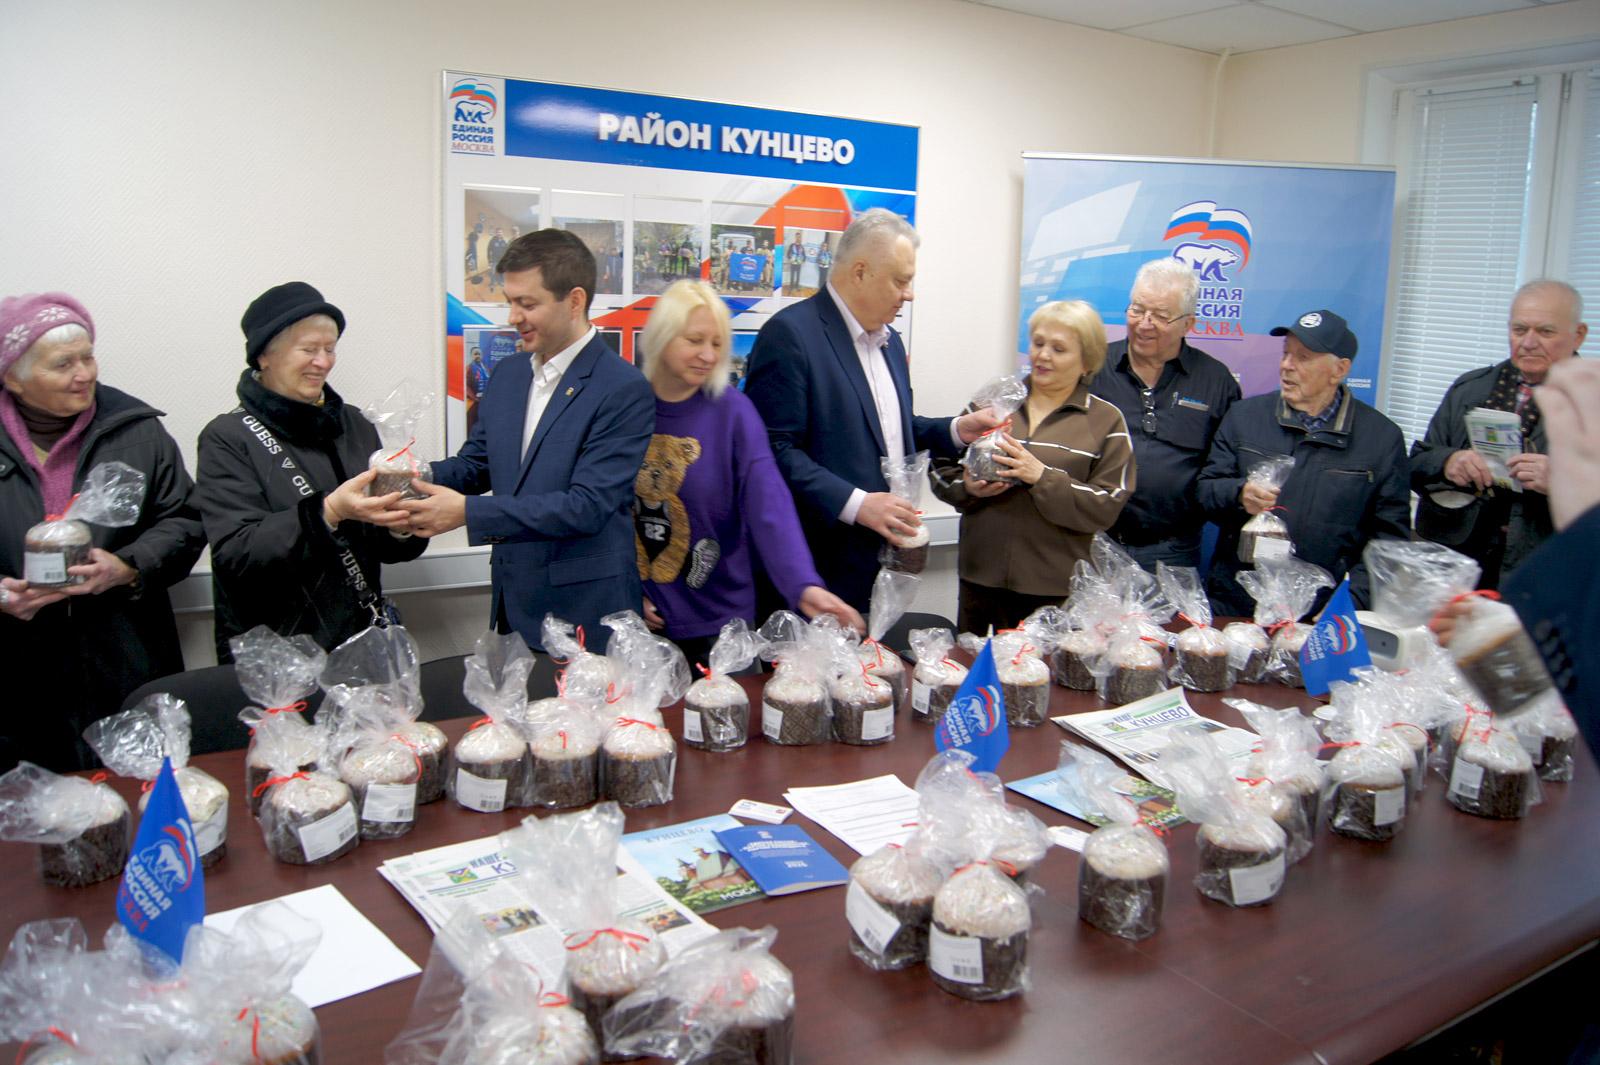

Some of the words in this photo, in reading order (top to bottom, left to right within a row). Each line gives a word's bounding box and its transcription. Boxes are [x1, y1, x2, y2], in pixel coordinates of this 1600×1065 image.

[452, 124, 493, 134] ЕДИНАЯ
[452, 133, 493, 143] РОССИЯ
[599, 111, 712, 150] РАЙОН
[721, 126, 855, 165] КУНЦЕВО
[452, 142, 495, 153] МОСКВА
[1197, 287, 1243, 301] НАЯ
[1195, 303, 1241, 318] СИЯ
[1189, 321, 1245, 337] СКВА
[242, 415, 283, 455] GUESS
[1129, 705, 1190, 728] КУНЦЕВО
